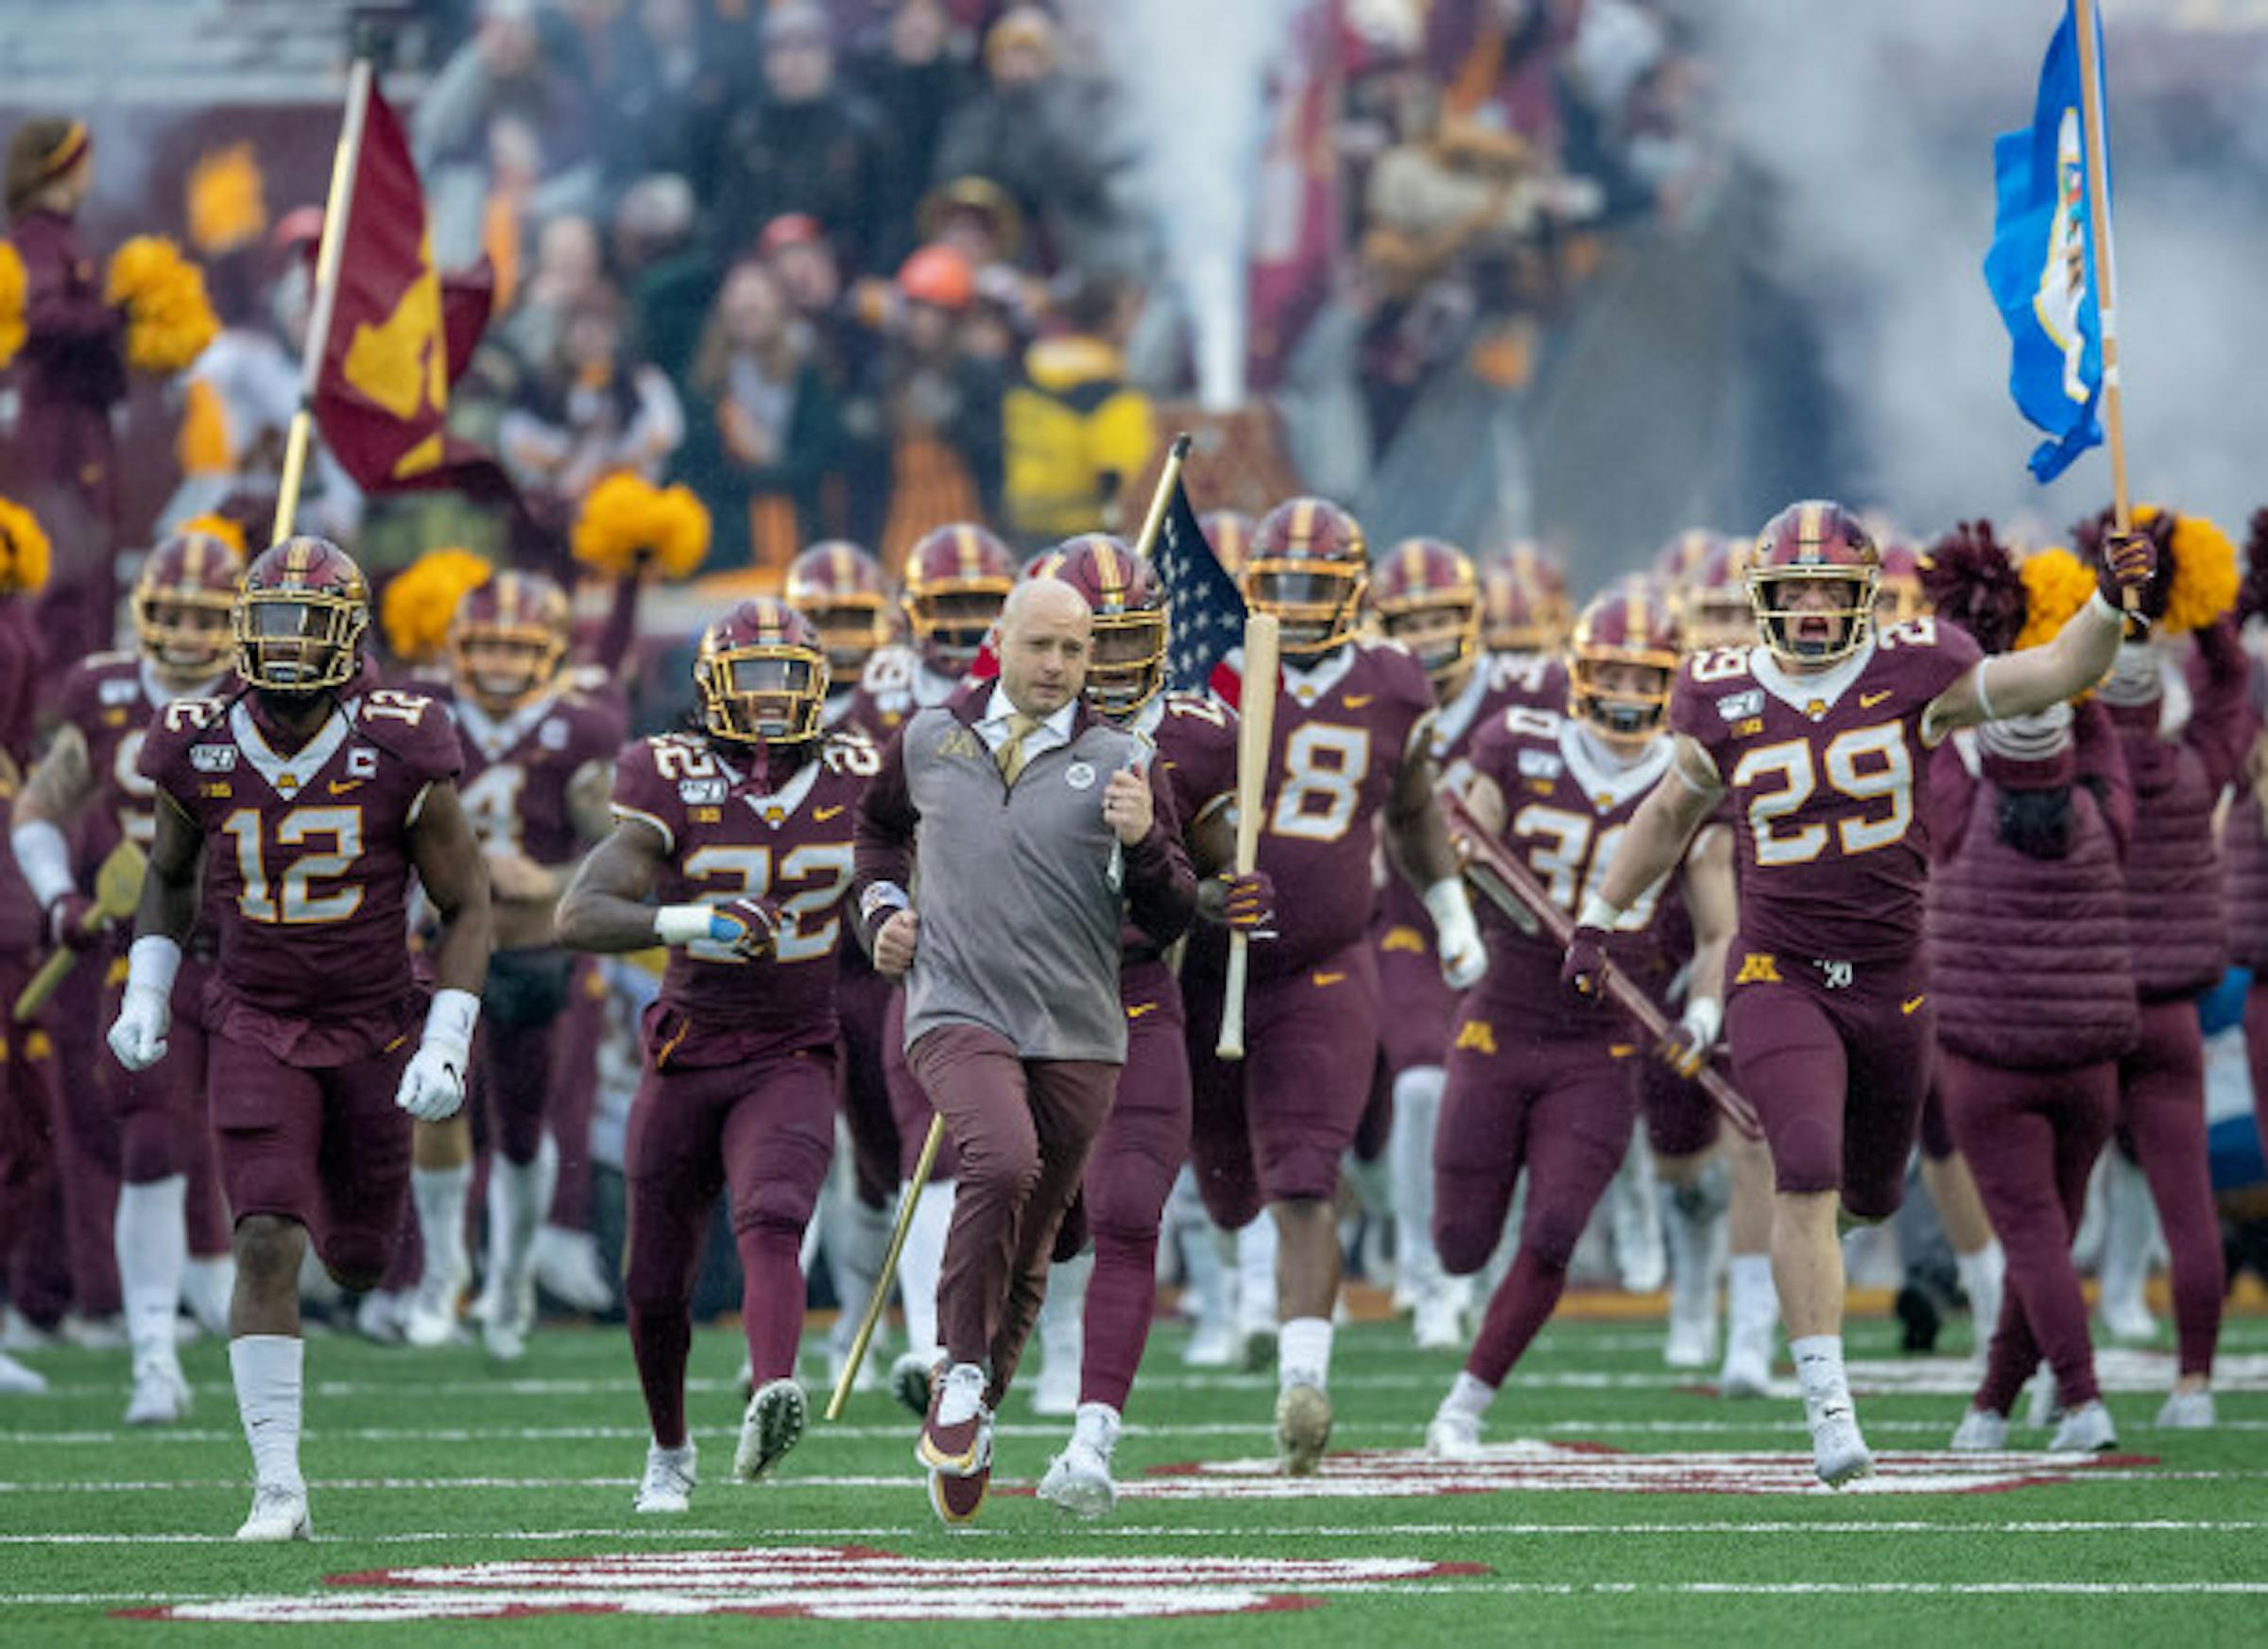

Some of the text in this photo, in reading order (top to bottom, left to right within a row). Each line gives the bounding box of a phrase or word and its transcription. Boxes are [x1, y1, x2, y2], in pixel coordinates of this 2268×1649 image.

[362, 689, 432, 726] 12
[1732, 719, 1914, 866] 29
[221, 805, 366, 924] 12
[682, 843, 855, 964] 22
